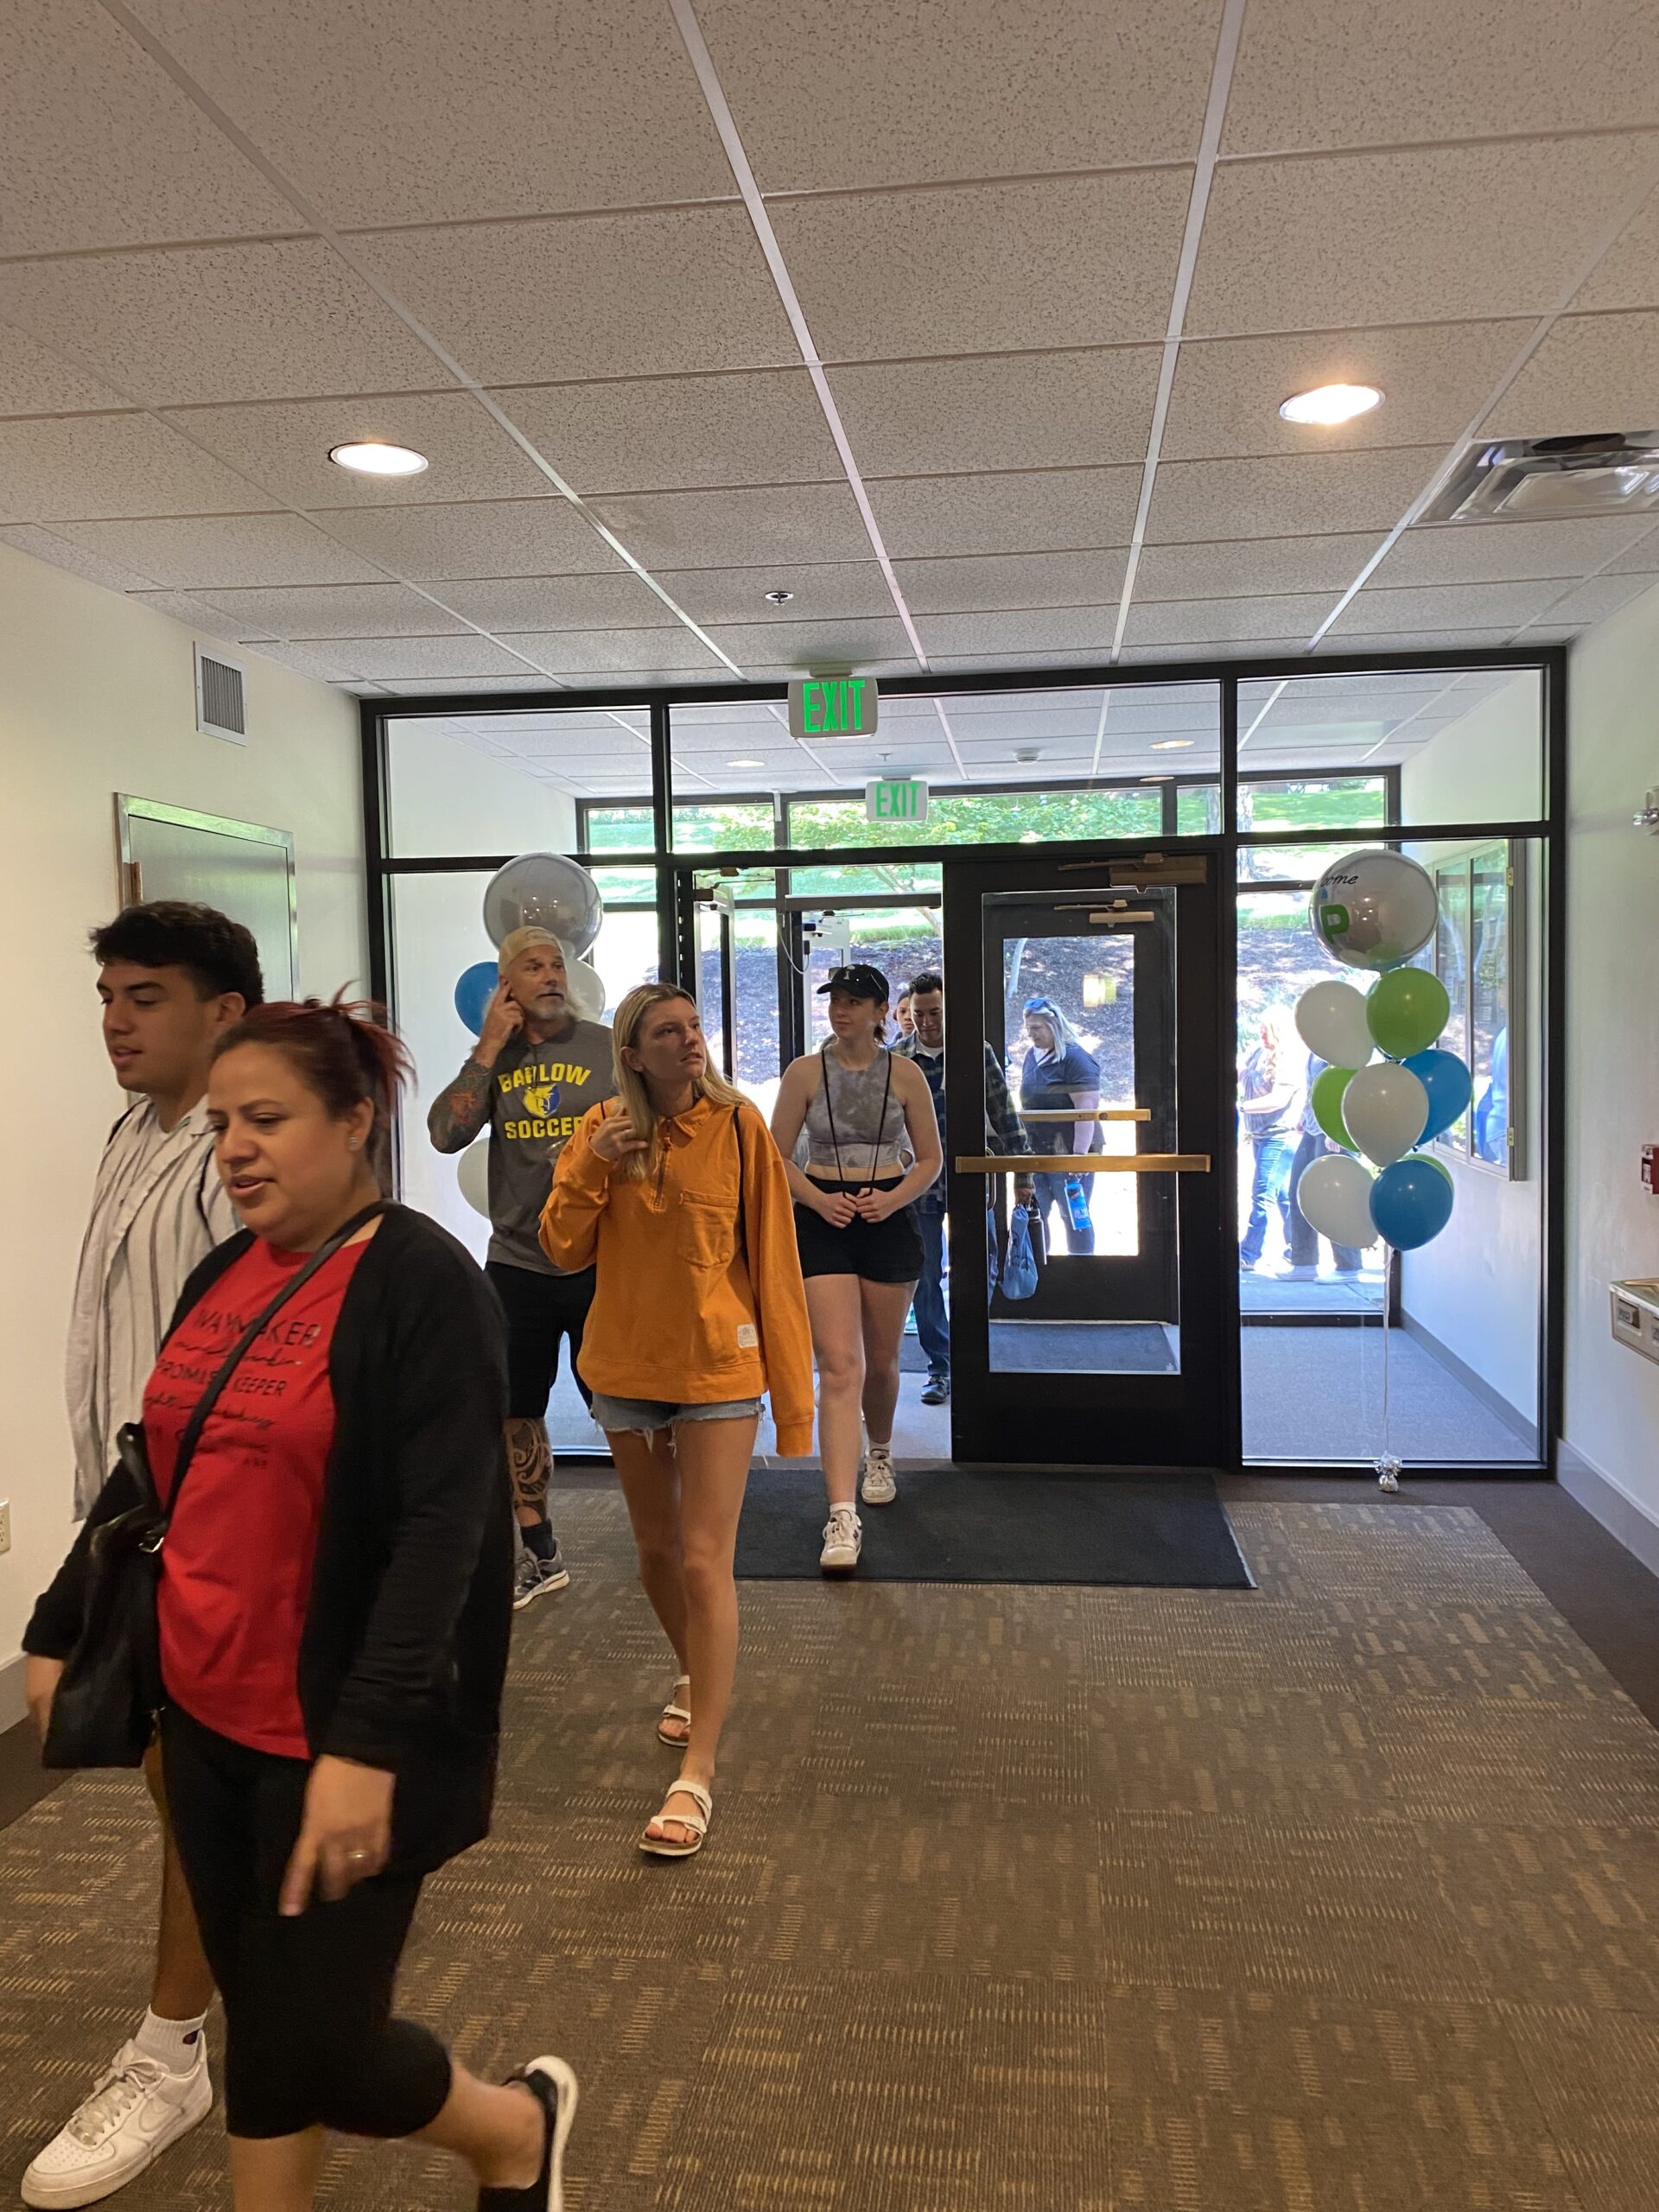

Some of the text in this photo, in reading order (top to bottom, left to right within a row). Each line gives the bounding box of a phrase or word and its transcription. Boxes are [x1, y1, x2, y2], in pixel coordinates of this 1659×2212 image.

[803, 679, 866, 733] EXIT
[875, 782, 920, 818] EXIT
[498, 1063, 591, 1093] BARLOW
